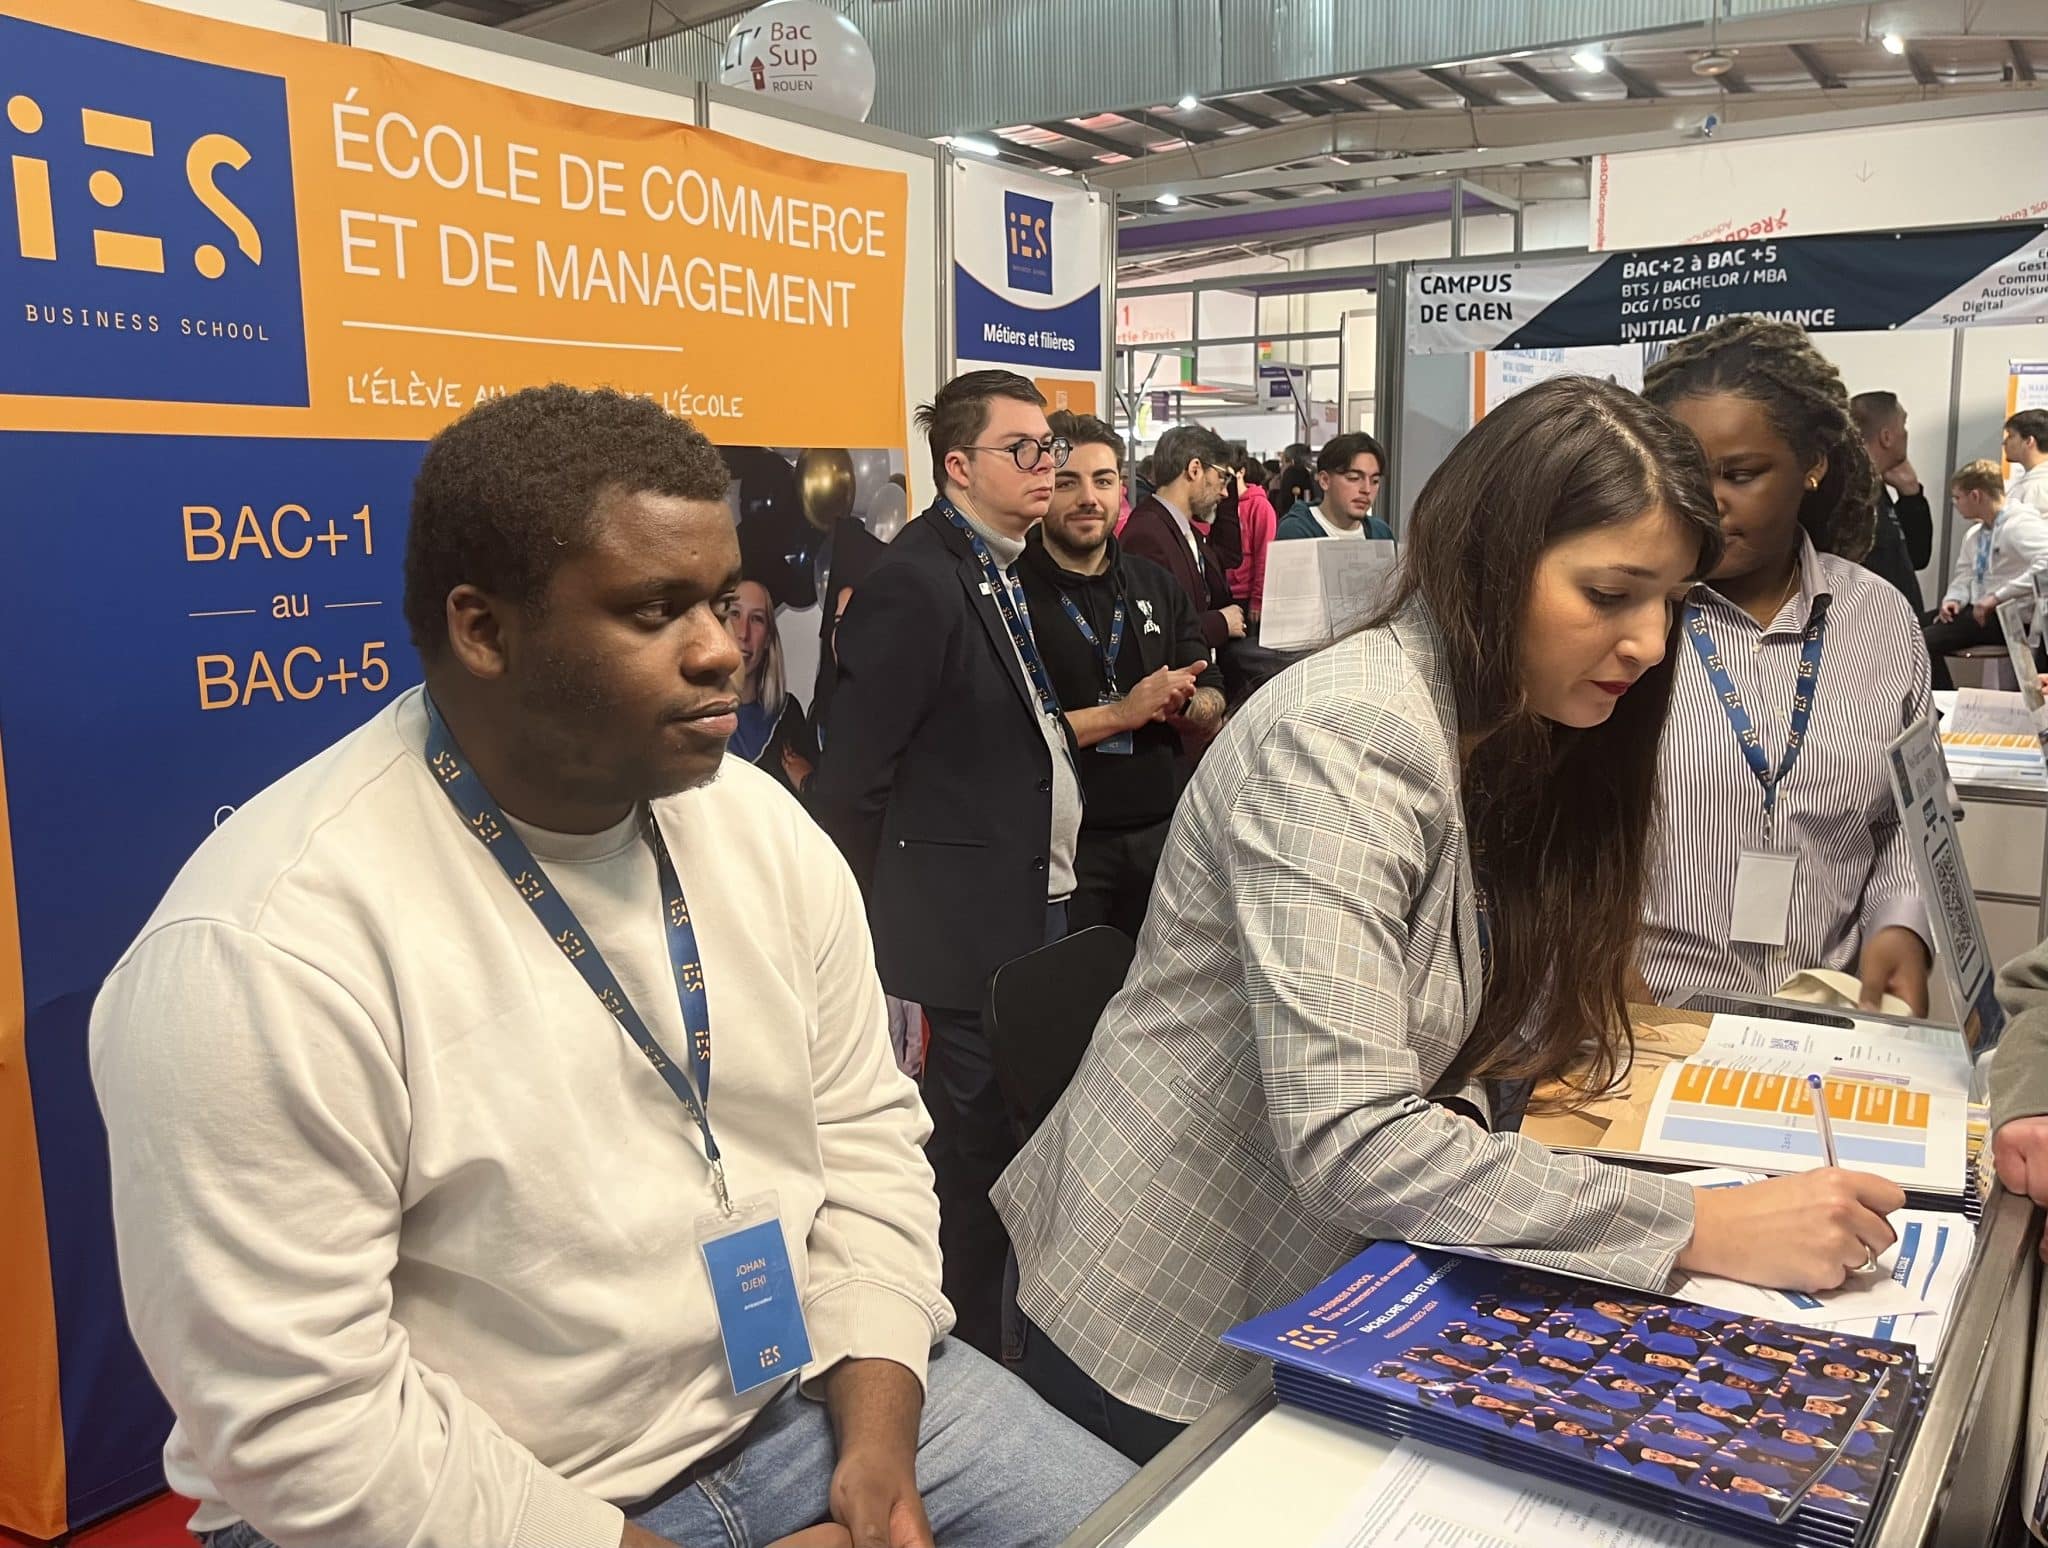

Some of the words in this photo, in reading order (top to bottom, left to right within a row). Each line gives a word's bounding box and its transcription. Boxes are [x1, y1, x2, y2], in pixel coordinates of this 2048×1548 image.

[771, 22, 812, 41] Bac
[769, 44, 817, 71] Sup
[773, 80, 813, 92] ROUEN
[332, 88, 541, 204] ÉCOLE
[559, 153, 626, 216] DE
[641, 165, 886, 257] COMMERCE
[340, 209, 418, 279] ET
[439, 224, 517, 294] DE
[536, 240, 855, 328] MANAGEMENT
[1622, 256, 1685, 279] BAC+2
[1690, 254, 1701, 272] à
[1707, 248, 1745, 270] BAC
[1751, 245, 1777, 264] +5
[1420, 274, 1512, 295] CAMPUS
[1621, 283, 1650, 298] BTS
[1662, 272, 1739, 294] BACHELOR
[1753, 268, 1787, 283] MBA
[1420, 304, 1448, 324] DE
[1455, 302, 1513, 321] CAEN
[1621, 299, 1649, 315] DCG
[1662, 294, 1701, 311] DSCG
[1962, 300, 2003, 312] Digital
[25, 303, 160, 333] BUSINESS
[181, 318, 270, 341] SCHOOL
[1621, 318, 1687, 338] INITIAL
[1942, 313, 1976, 324] Sport
[984, 323, 1026, 346] Métiers
[1028, 333, 1039, 348] et
[1040, 331, 1075, 352] filières
[347, 367, 462, 408] L'ÉLÈVE
[664, 384, 744, 418] L'ÉCOLE
[182, 504, 373, 562] BAC+1
[272, 593, 309, 618] au
[197, 641, 390, 710] BAC+5
[736, 1258, 766, 1277] JOHAN
